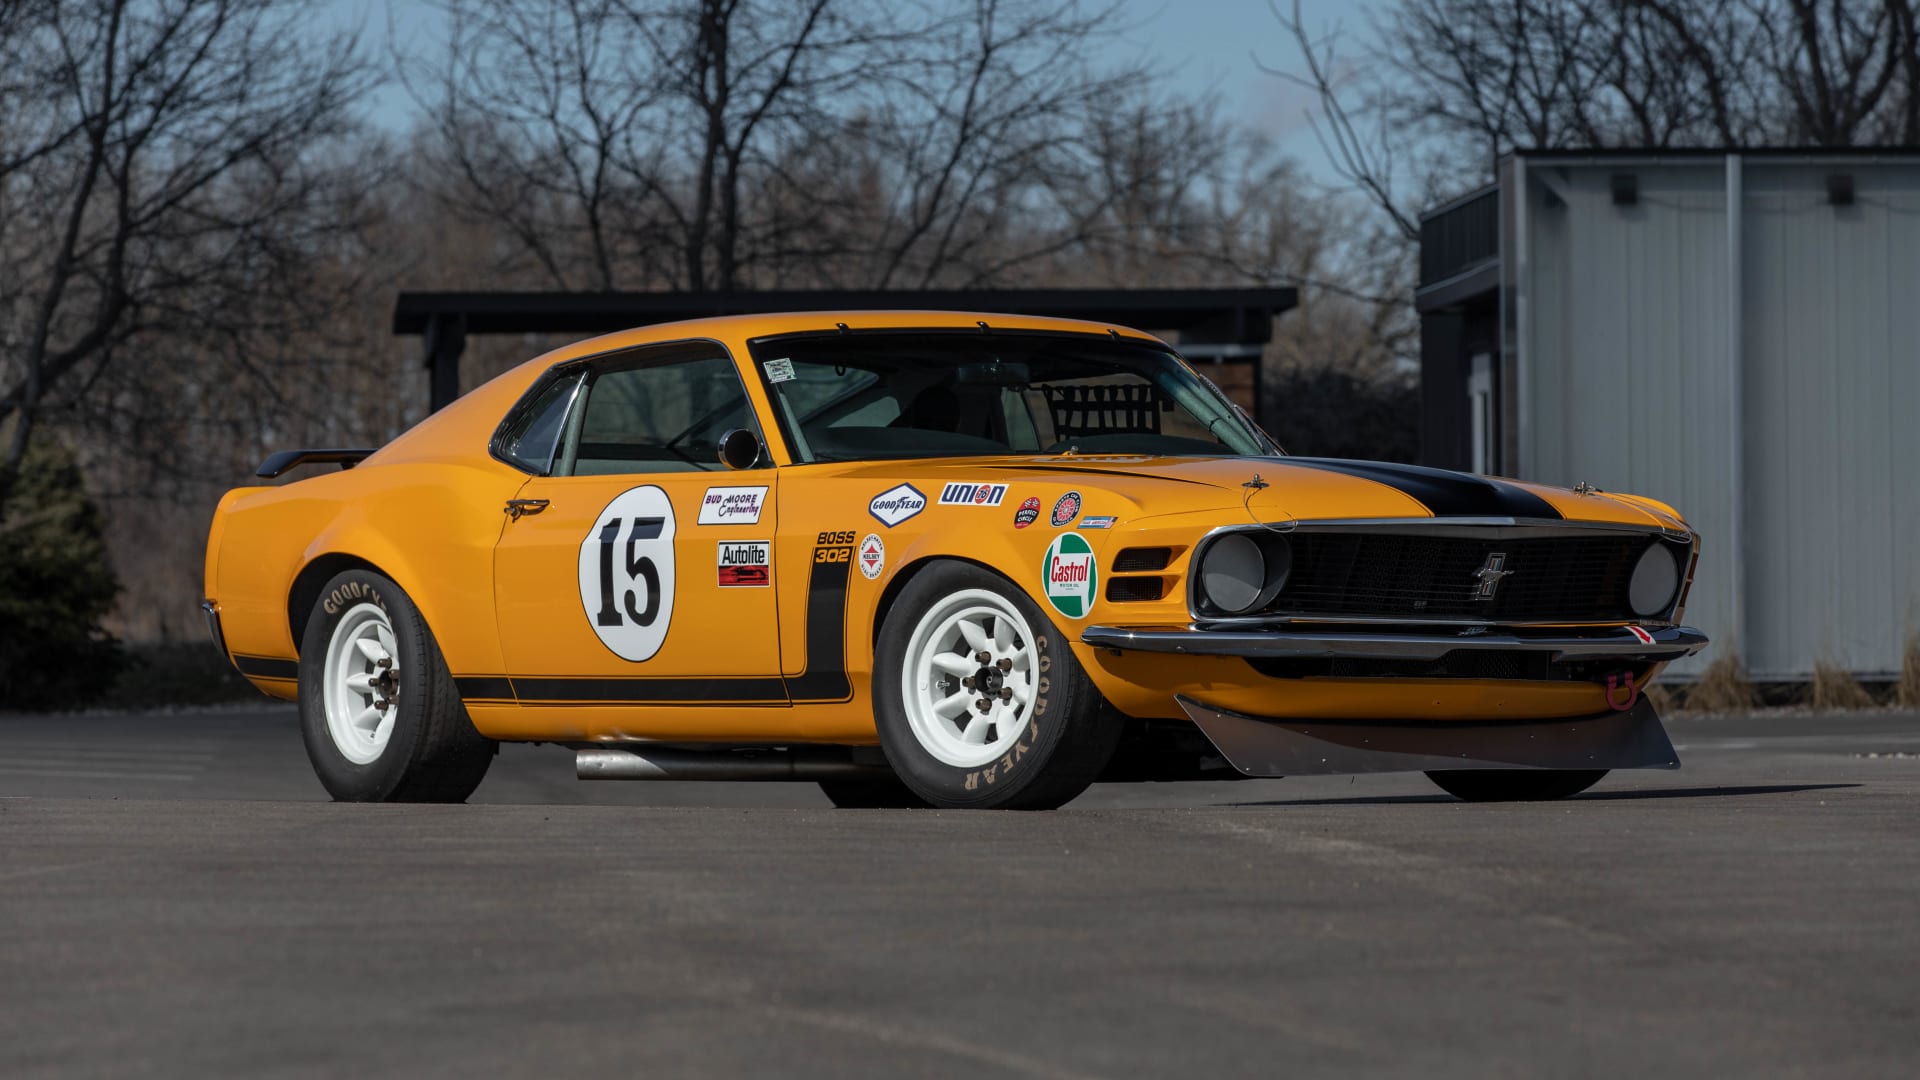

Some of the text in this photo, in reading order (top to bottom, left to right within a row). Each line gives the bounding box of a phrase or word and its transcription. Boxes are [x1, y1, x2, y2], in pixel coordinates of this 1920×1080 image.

[705, 494, 757, 504] BUD MOORE
[718, 498, 759, 517] Engineering
[872, 498, 922, 512] GOODYEAR
[817, 531, 856, 545] BOSS
[722, 545, 765, 565] Autolite
[815, 548, 850, 563] 302
[596, 516, 666, 627] 15
[1051, 556, 1089, 582] Castrol
[964, 635, 1050, 790] GOODYEAR
